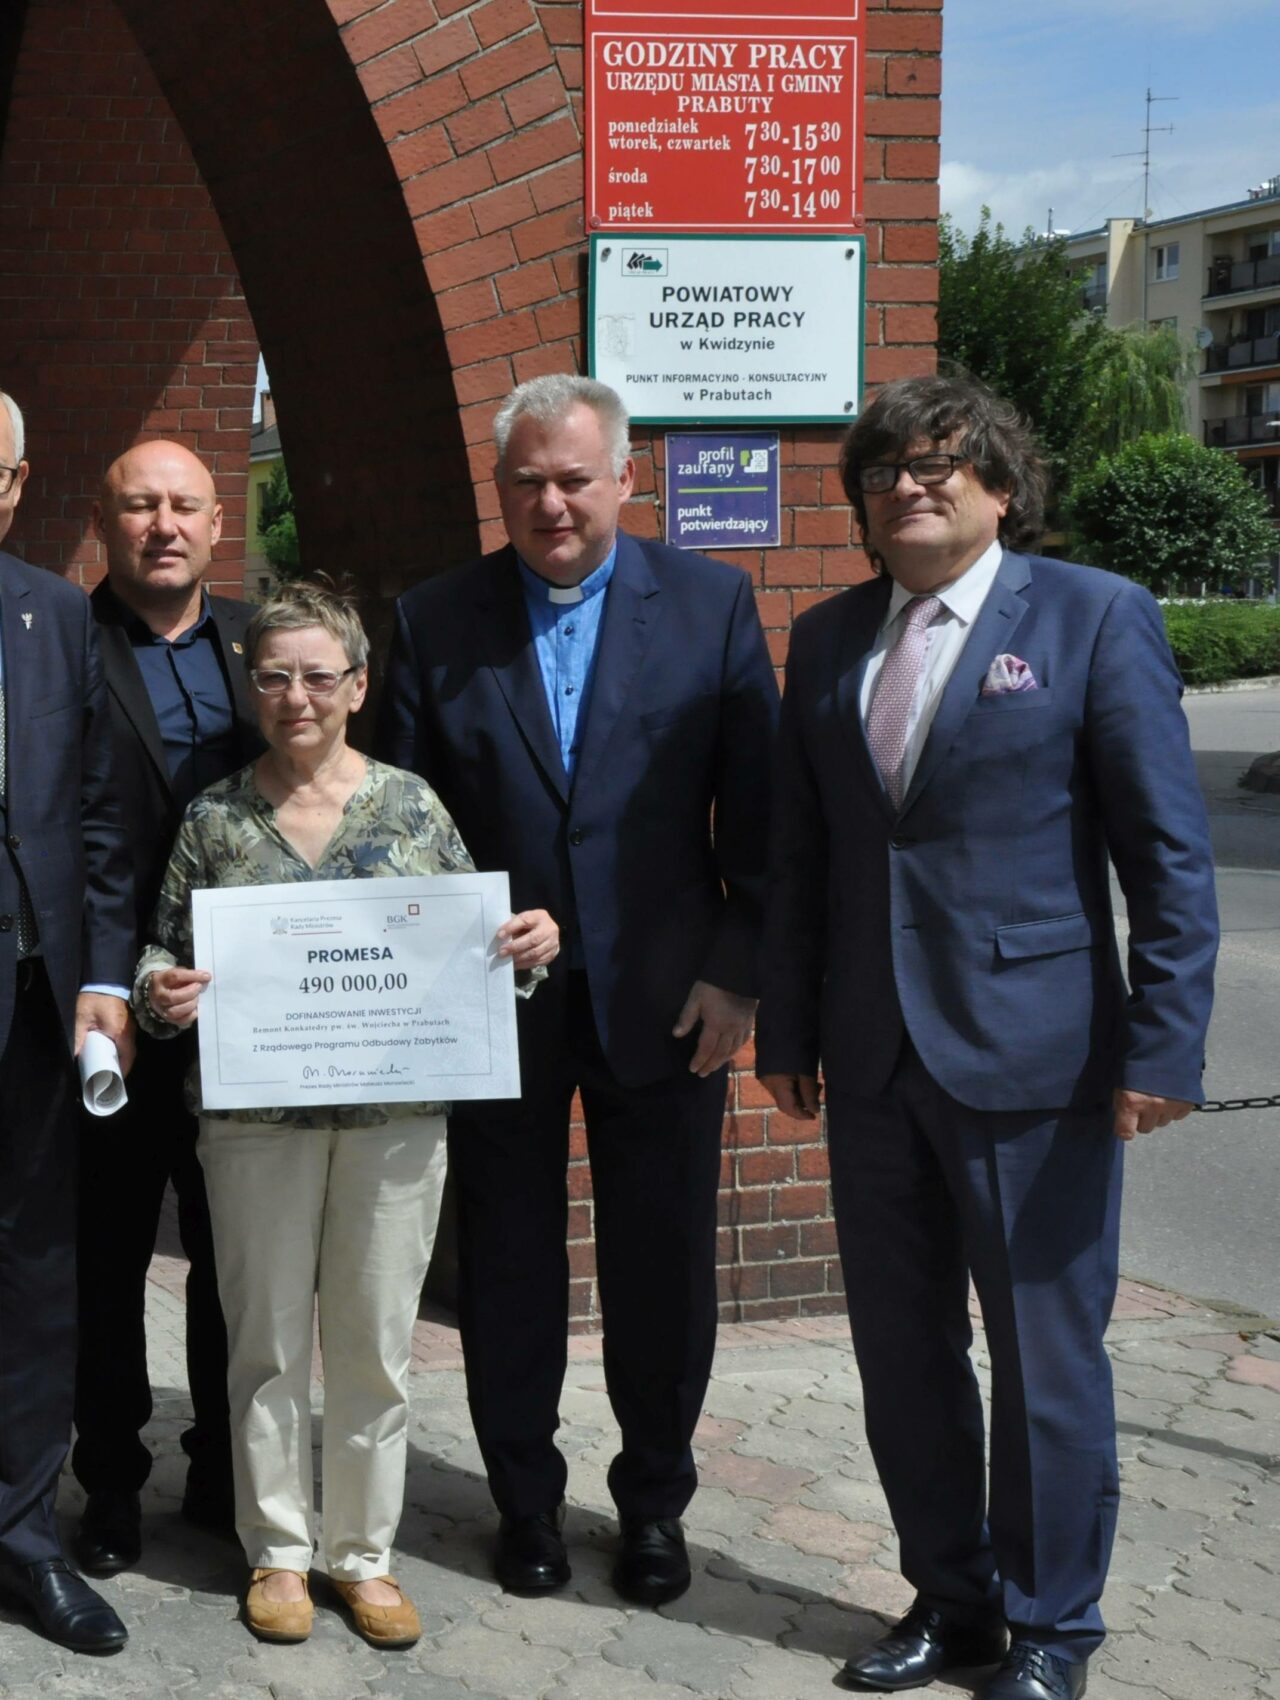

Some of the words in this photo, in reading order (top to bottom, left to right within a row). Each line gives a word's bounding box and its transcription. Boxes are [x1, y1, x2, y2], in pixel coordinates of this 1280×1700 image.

[603, 41, 738, 67] GODZINY
[748, 44, 847, 70] PRACY
[606, 72, 685, 96] URZĘDU
[691, 73, 761, 93] MIASTA
[767, 74, 775, 93] I
[781, 74, 843, 94] GMINY
[677, 96, 774, 113] PRABUTY
[608, 118, 699, 135] poniedziałek
[608, 134, 663, 153] wtorek,
[666, 135, 731, 151] czwartek
[608, 167, 648, 184] środa
[608, 202, 654, 221] piątek
[662, 286, 793, 302] POWIATOWY
[649, 312, 725, 332] URZĄD
[733, 311, 806, 328] PRACY
[680, 340, 693, 350] w
[699, 337, 775, 352] Kwidzynie
[626, 374, 659, 383] PUNKT
[662, 374, 739, 383] INFORMACYJNO
[749, 373, 828, 382] KONSULTACYJNY
[683, 391, 694, 400] w
[700, 388, 772, 401] Prabutach
[699, 446, 735, 464] profil
[677, 462, 735, 478] zaufany
[677, 504, 712, 521] punkt
[680, 517, 769, 535] potwierdzający
[386, 914, 408, 924] BGK
[307, 946, 394, 964] PROMESA
[299, 976, 335, 994] 490
[341, 972, 408, 994] 000,00
[285, 1009, 366, 1020] DOFINANSOWANIE
[368, 1007, 422, 1017] INWESTYCJI
[253, 1026, 282, 1034] Remont
[253, 1044, 258, 1052] Z
[260, 1042, 313, 1053] Rządowego
[314, 1040, 360, 1051] Programu
[361, 1038, 411, 1047] Odbudowy
[413, 1036, 458, 1047] Zabytków
